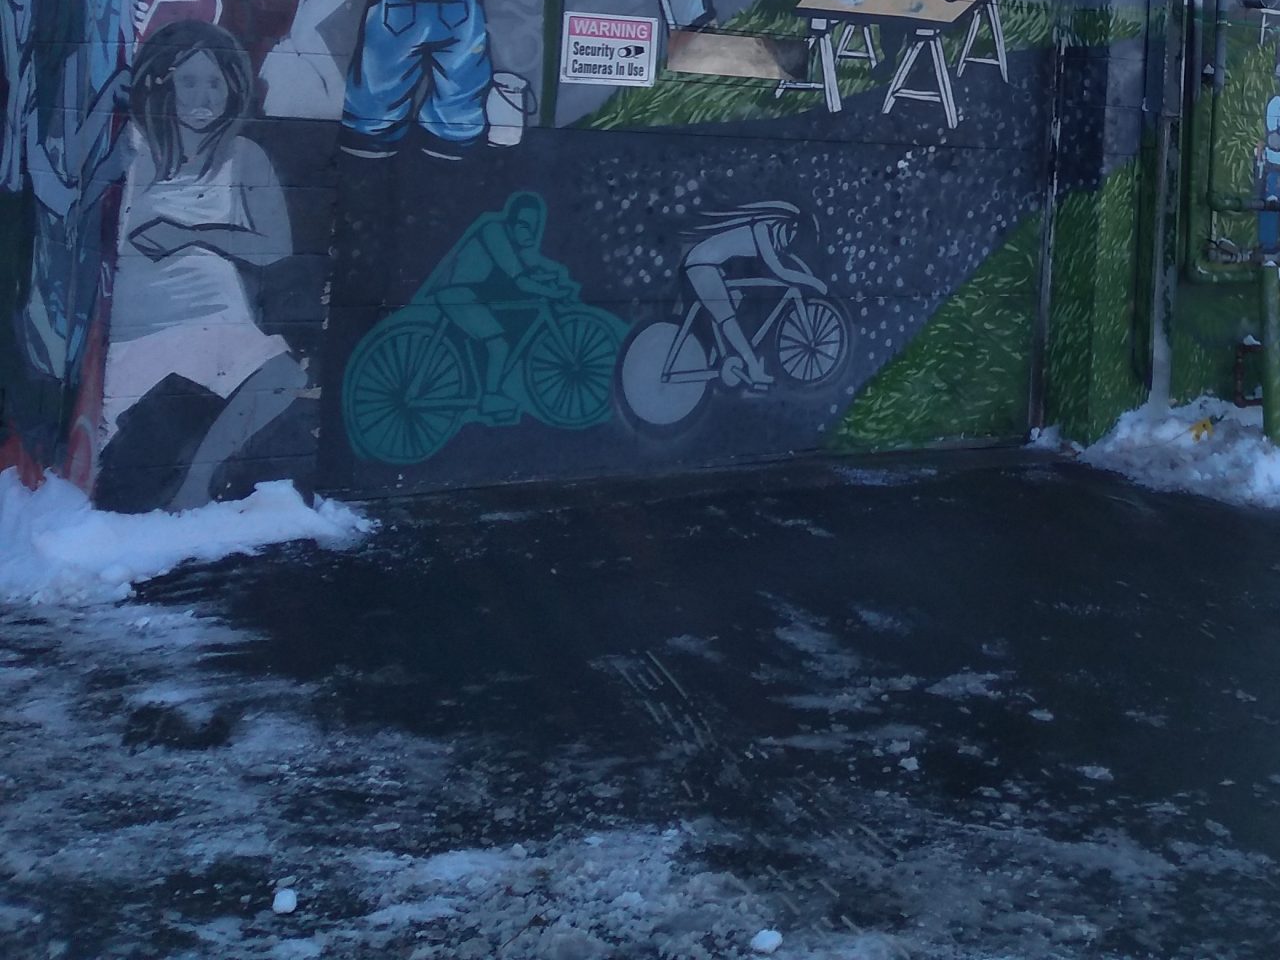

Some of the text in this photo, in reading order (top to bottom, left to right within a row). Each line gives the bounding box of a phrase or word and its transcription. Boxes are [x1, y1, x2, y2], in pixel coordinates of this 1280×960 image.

[573, 19, 648, 39] WARNING
[573, 41, 616, 60] Security
[571, 59, 644, 77] Cameras In Use
